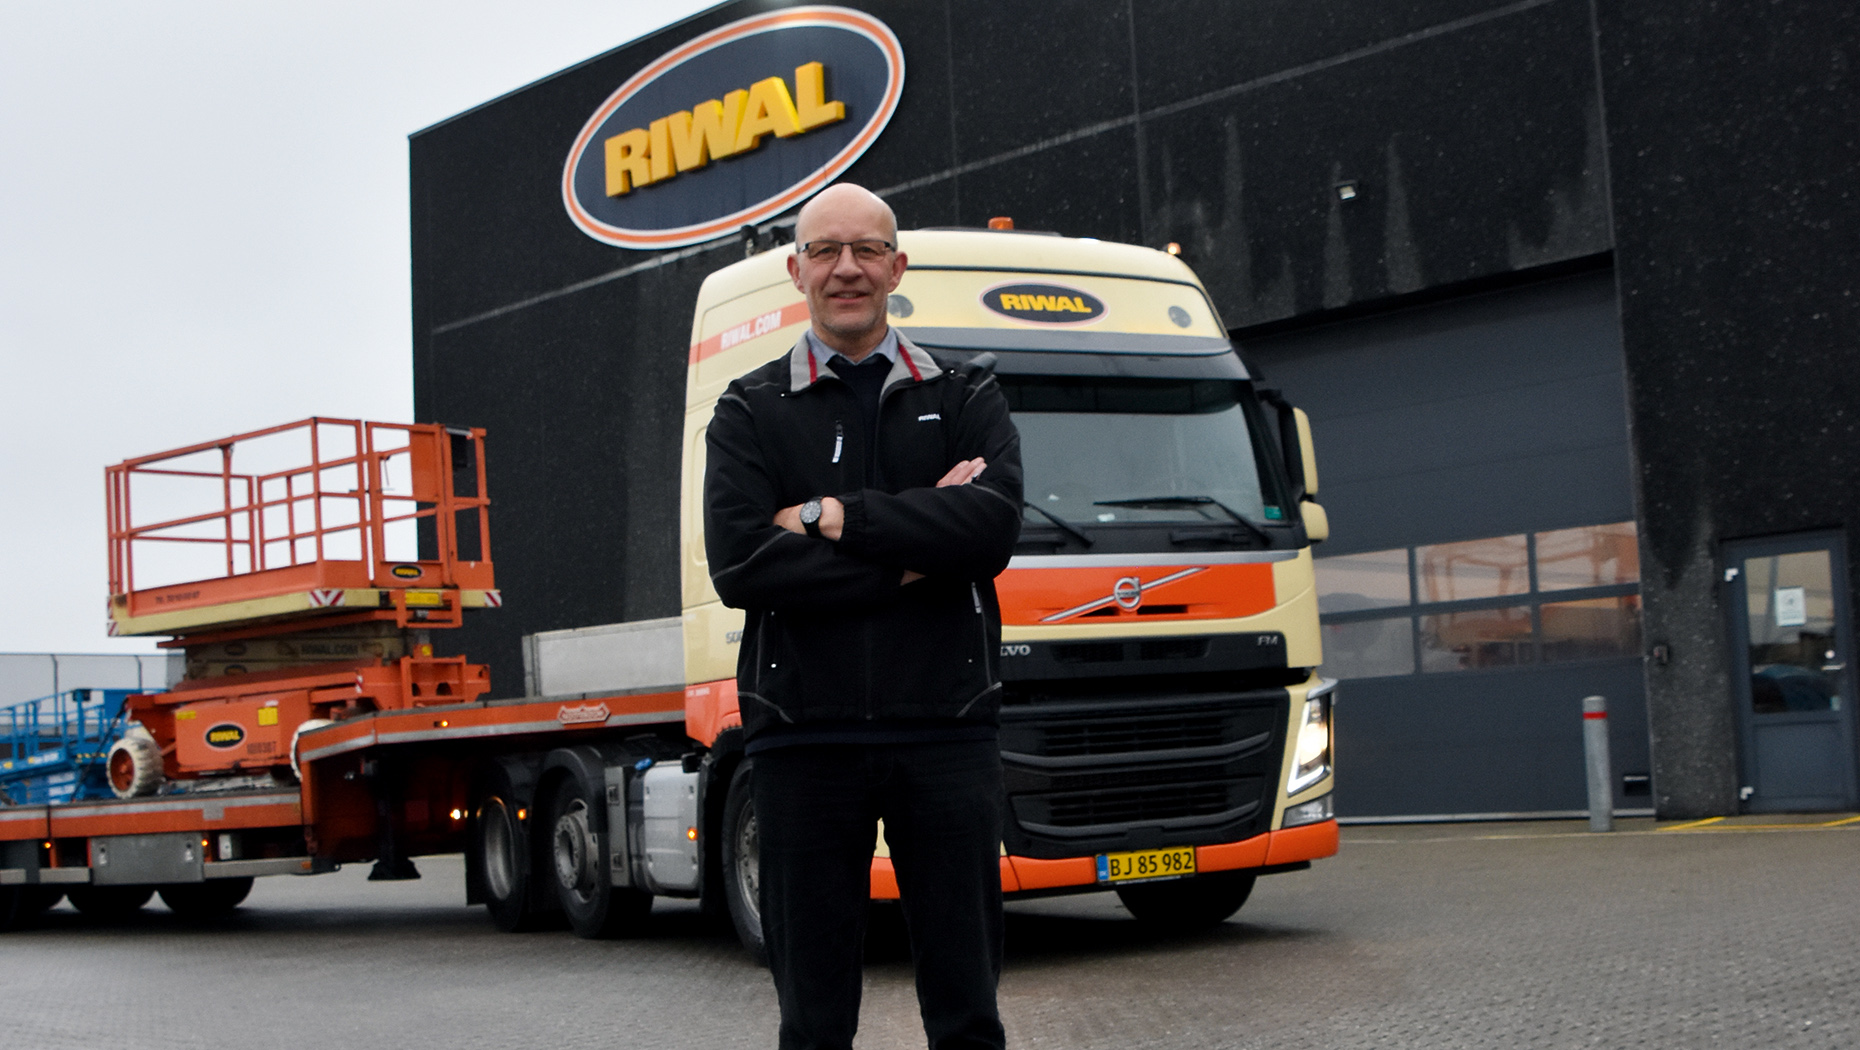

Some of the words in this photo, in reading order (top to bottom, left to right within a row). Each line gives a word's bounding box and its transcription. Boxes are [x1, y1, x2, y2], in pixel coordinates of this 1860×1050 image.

[605, 61, 845, 197] RIWAL
[1000, 293, 1092, 313] RIWAL
[721, 310, 782, 351] RIWAL.COM
[1257, 635, 1279, 646] FM
[209, 730, 241, 742] RIWAL
[1110, 858, 1133, 876] BJ
[1138, 855, 1158, 874] 85
[1162, 852, 1193, 872] 982
